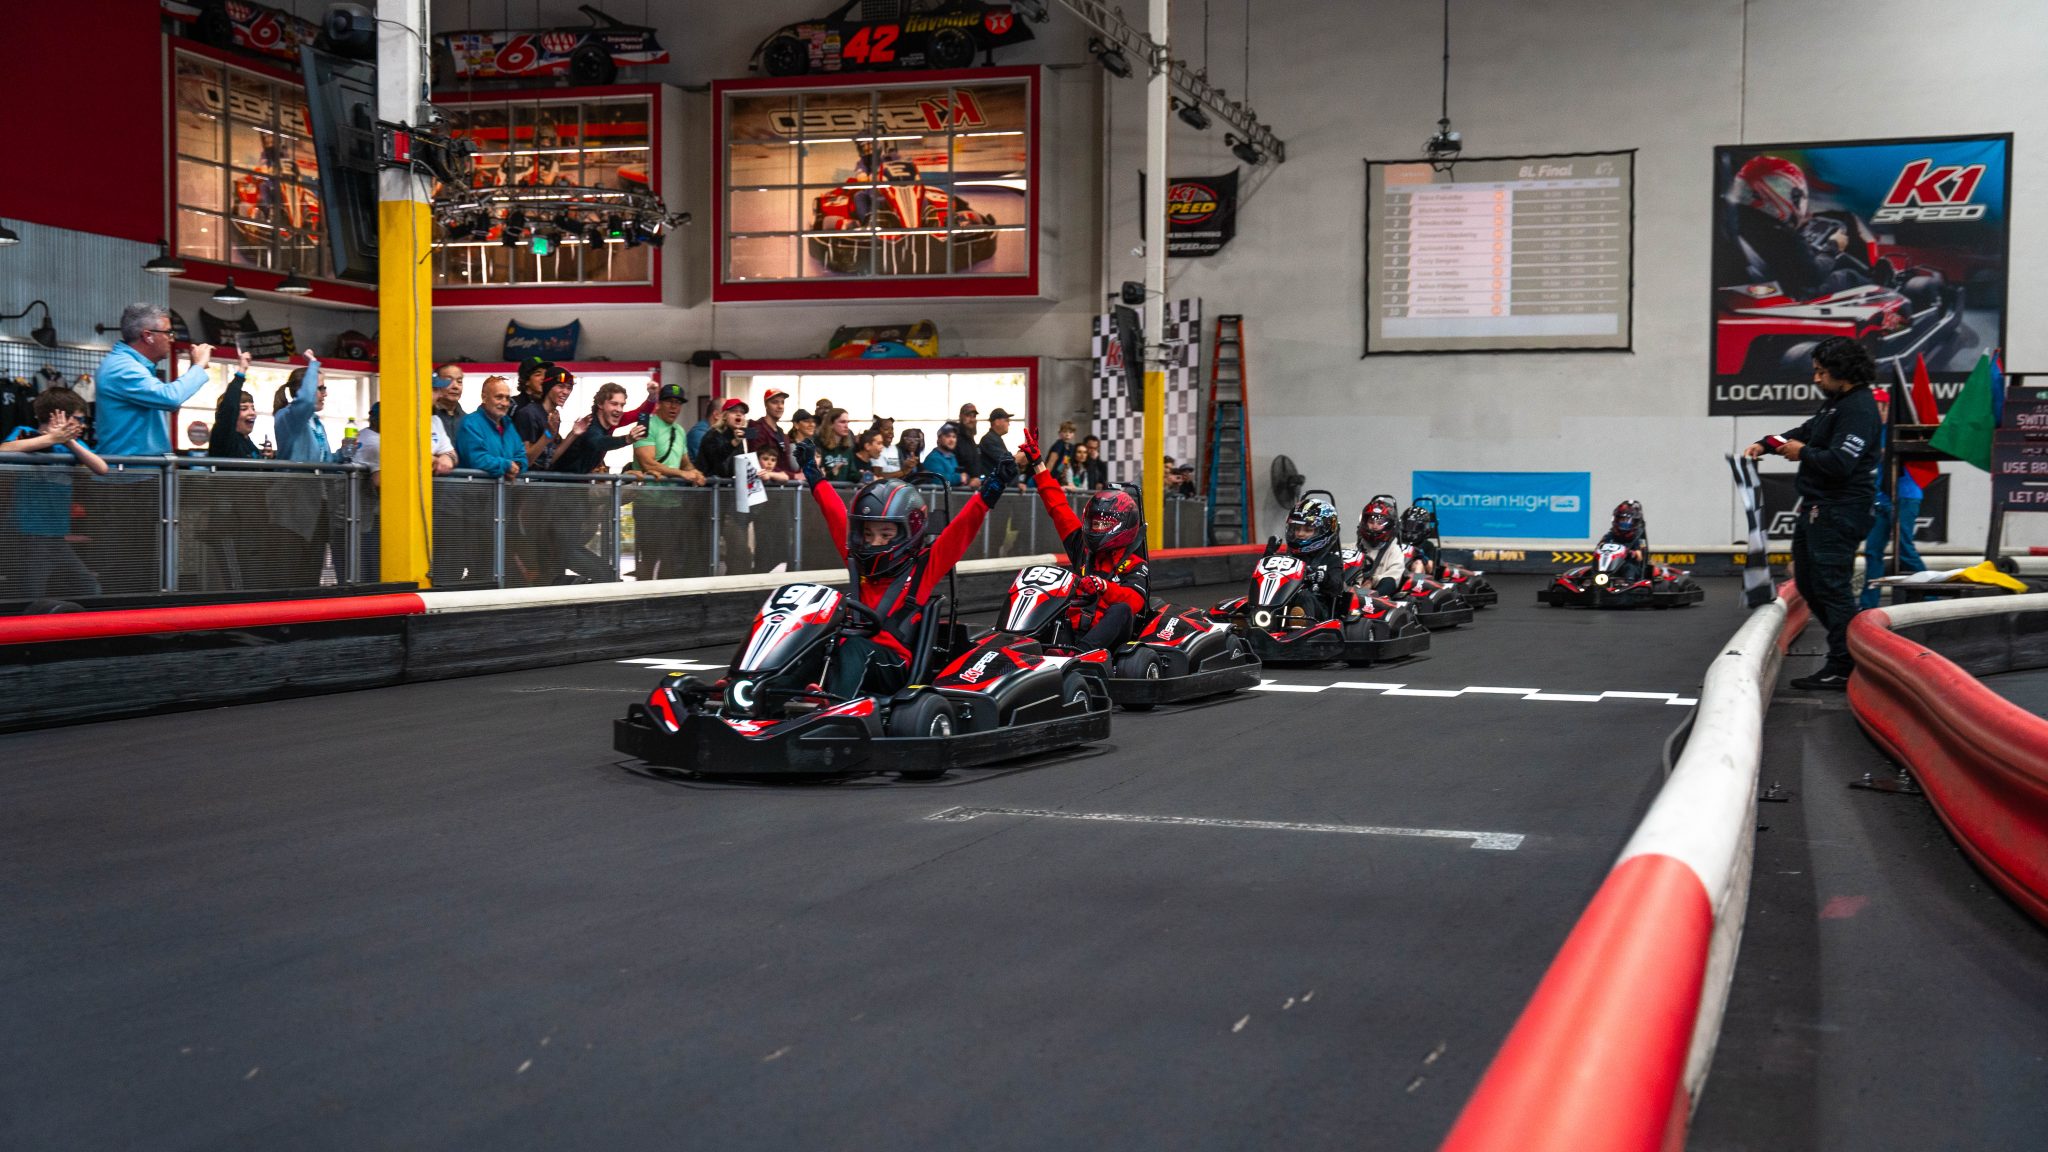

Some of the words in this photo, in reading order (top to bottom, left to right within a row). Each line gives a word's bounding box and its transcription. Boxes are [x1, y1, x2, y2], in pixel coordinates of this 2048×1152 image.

[250, 10, 282, 48] 6
[905, 9, 981, 33] Havoline
[543, 33, 576, 51] AAA
[843, 24, 900, 64] 42
[494, 33, 538, 74] 6
[1538, 163, 1573, 177] Final
[1884, 158, 1987, 206] K1
[1169, 186, 1197, 203] K1
[1168, 202, 1217, 214] PEED
[1869, 204, 1987, 225] SPEED
[1716, 384, 1827, 401] LOCATION
[2003, 461, 2028, 475] USE
[2030, 461, 2048, 475] BR
[2008, 491, 2033, 504] LET
[1473, 550, 1497, 561] SLOW
[1499, 550, 1525, 561] DOWN
[1667, 553, 1696, 565] DOWN
[1024, 566, 1064, 584] 85
